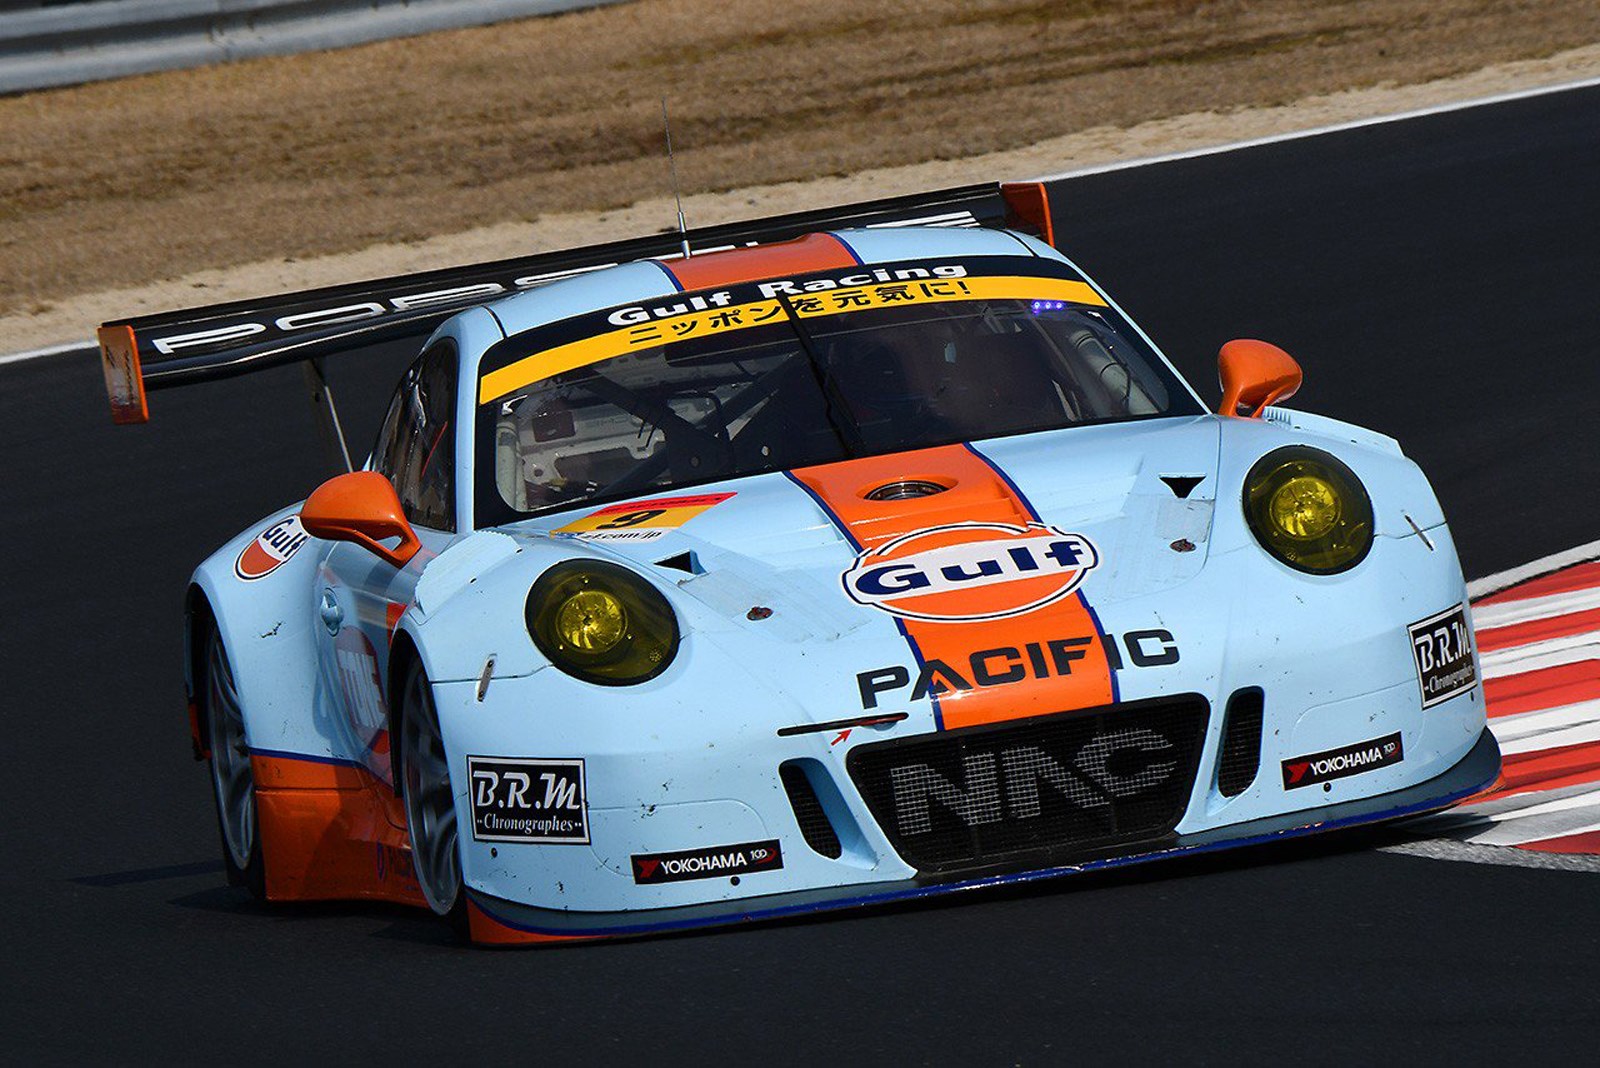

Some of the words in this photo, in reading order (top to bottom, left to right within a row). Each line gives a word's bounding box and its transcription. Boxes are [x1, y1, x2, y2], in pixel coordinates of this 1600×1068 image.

[607, 291, 731, 326] Gulf
[757, 264, 969, 298] Racing
[262, 518, 308, 558] Gulf
[595, 509, 667, 530] 9
[855, 541, 1084, 595] Gulf
[856, 629, 1180, 709] PACIFIC
[1310, 747, 1383, 776] YOKOHAMA
[473, 771, 580, 810] B.R.M
[484, 813, 573, 835] Chronographes
[661, 852, 748, 875] YOKOHAMA
